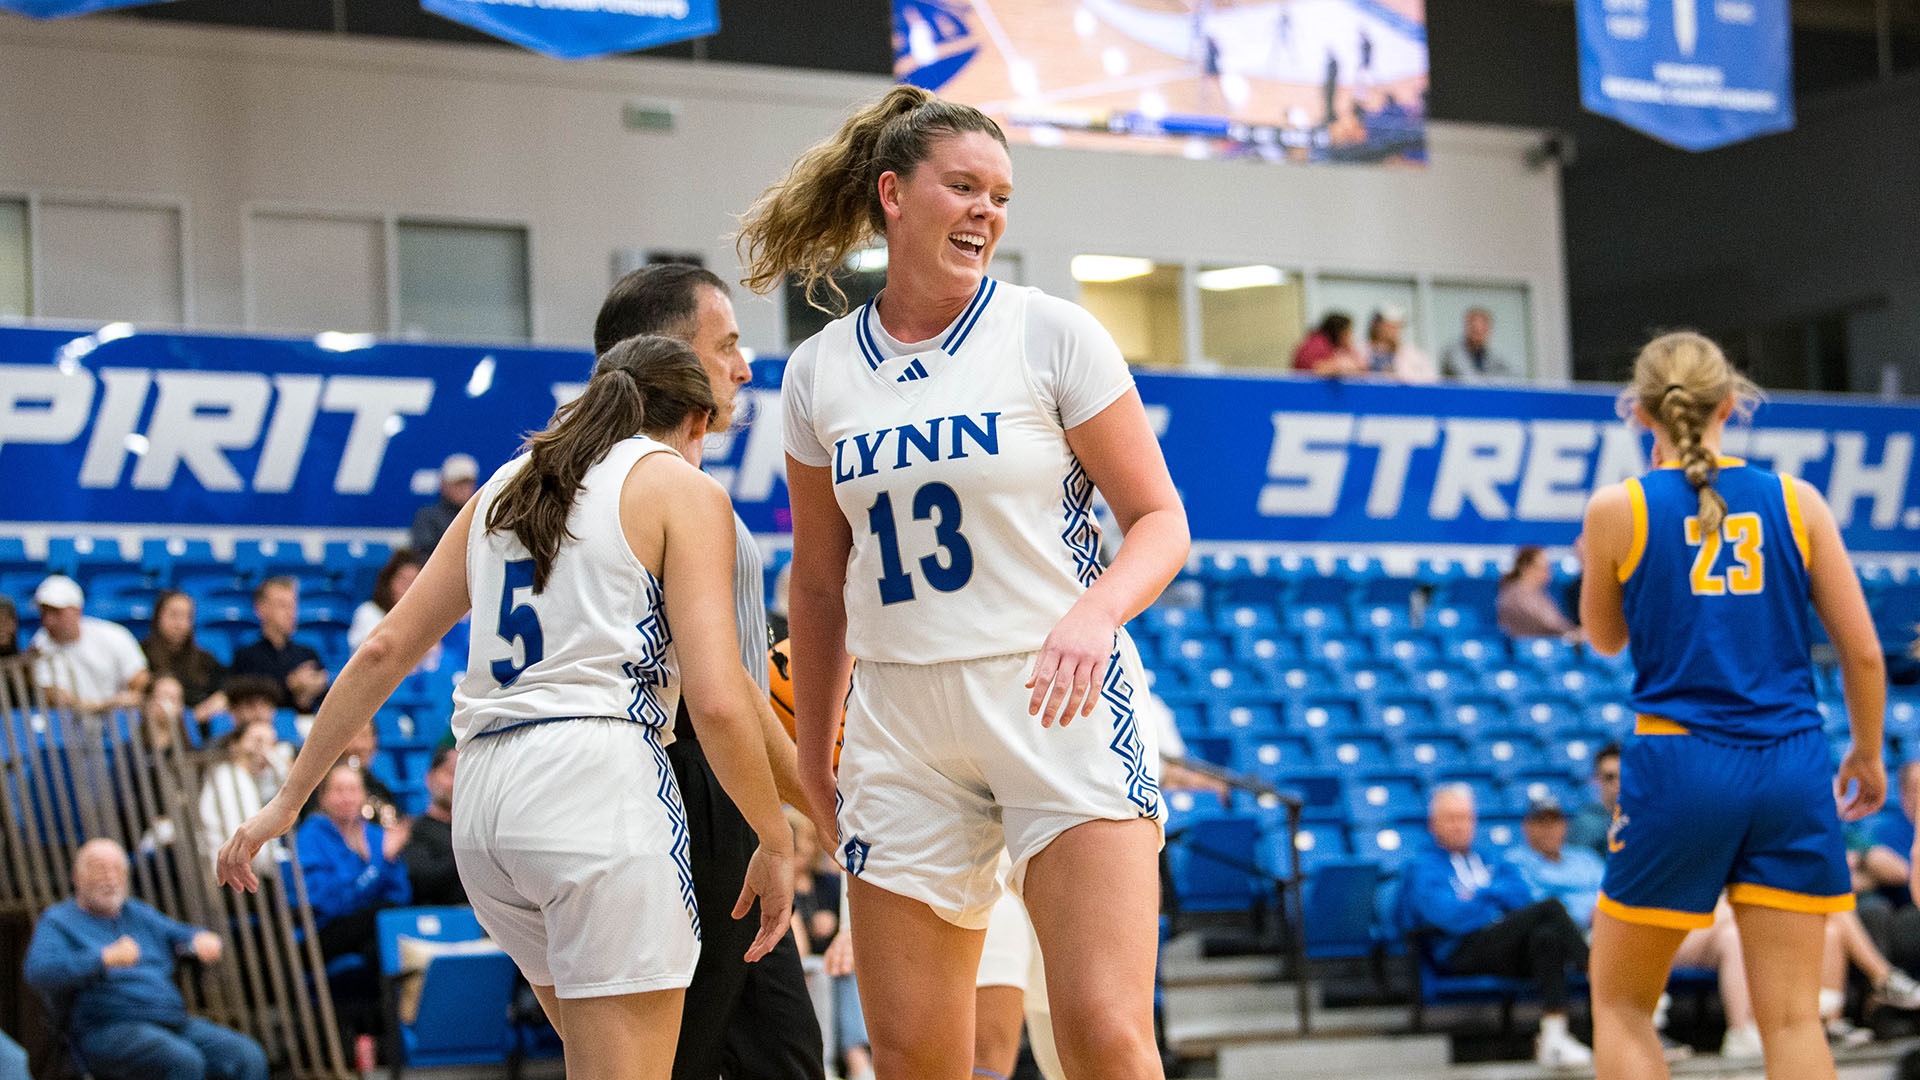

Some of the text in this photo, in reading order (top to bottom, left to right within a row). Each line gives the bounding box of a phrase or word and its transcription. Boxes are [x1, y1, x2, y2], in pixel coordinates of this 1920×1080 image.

[834, 412, 1001, 485] LYNN
[867, 481, 974, 606] 13
[1684, 512, 1764, 595] 23
[490, 557, 544, 690] 5
